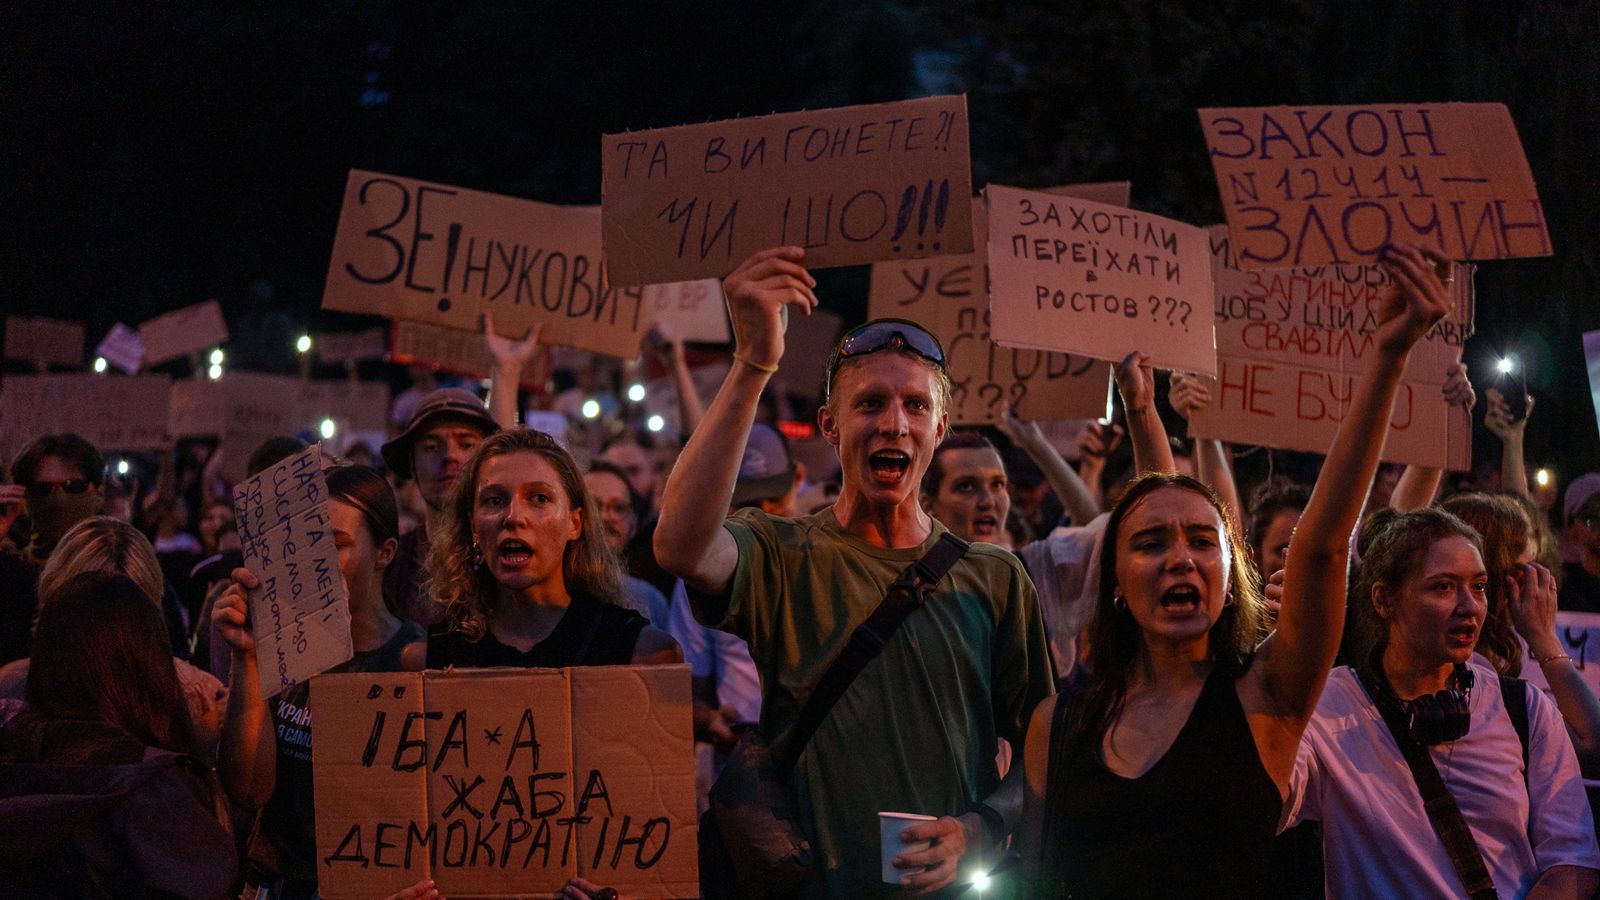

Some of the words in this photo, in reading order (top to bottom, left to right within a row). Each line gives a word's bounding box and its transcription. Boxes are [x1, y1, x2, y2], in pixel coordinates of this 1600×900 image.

[616, 141, 669, 179] ТА
[1210, 108, 1446, 160] ЗАКОН
[657, 196, 739, 260] ЧИ
[780, 177, 950, 253] ШО!!!
[1019, 199, 1178, 256] ЗАХОТІЛИ
[1237, 200, 1551, 266] ЗЛОЧИН
[1011, 234, 1181, 286] ПЕРЕЇХАТИ
[1278, 301, 1291, 321] У
[1241, 322, 1375, 360] СВАВІЛЛ
[1219, 361, 1275, 417] НЕ
[1296, 370, 1413, 430] БУО
[261, 576, 282, 643] проти
[312, 556, 340, 623] МЕНІ
[441, 768, 614, 821] ЖАБА
[324, 815, 671, 871] ДЕМОКРАТІЮ
